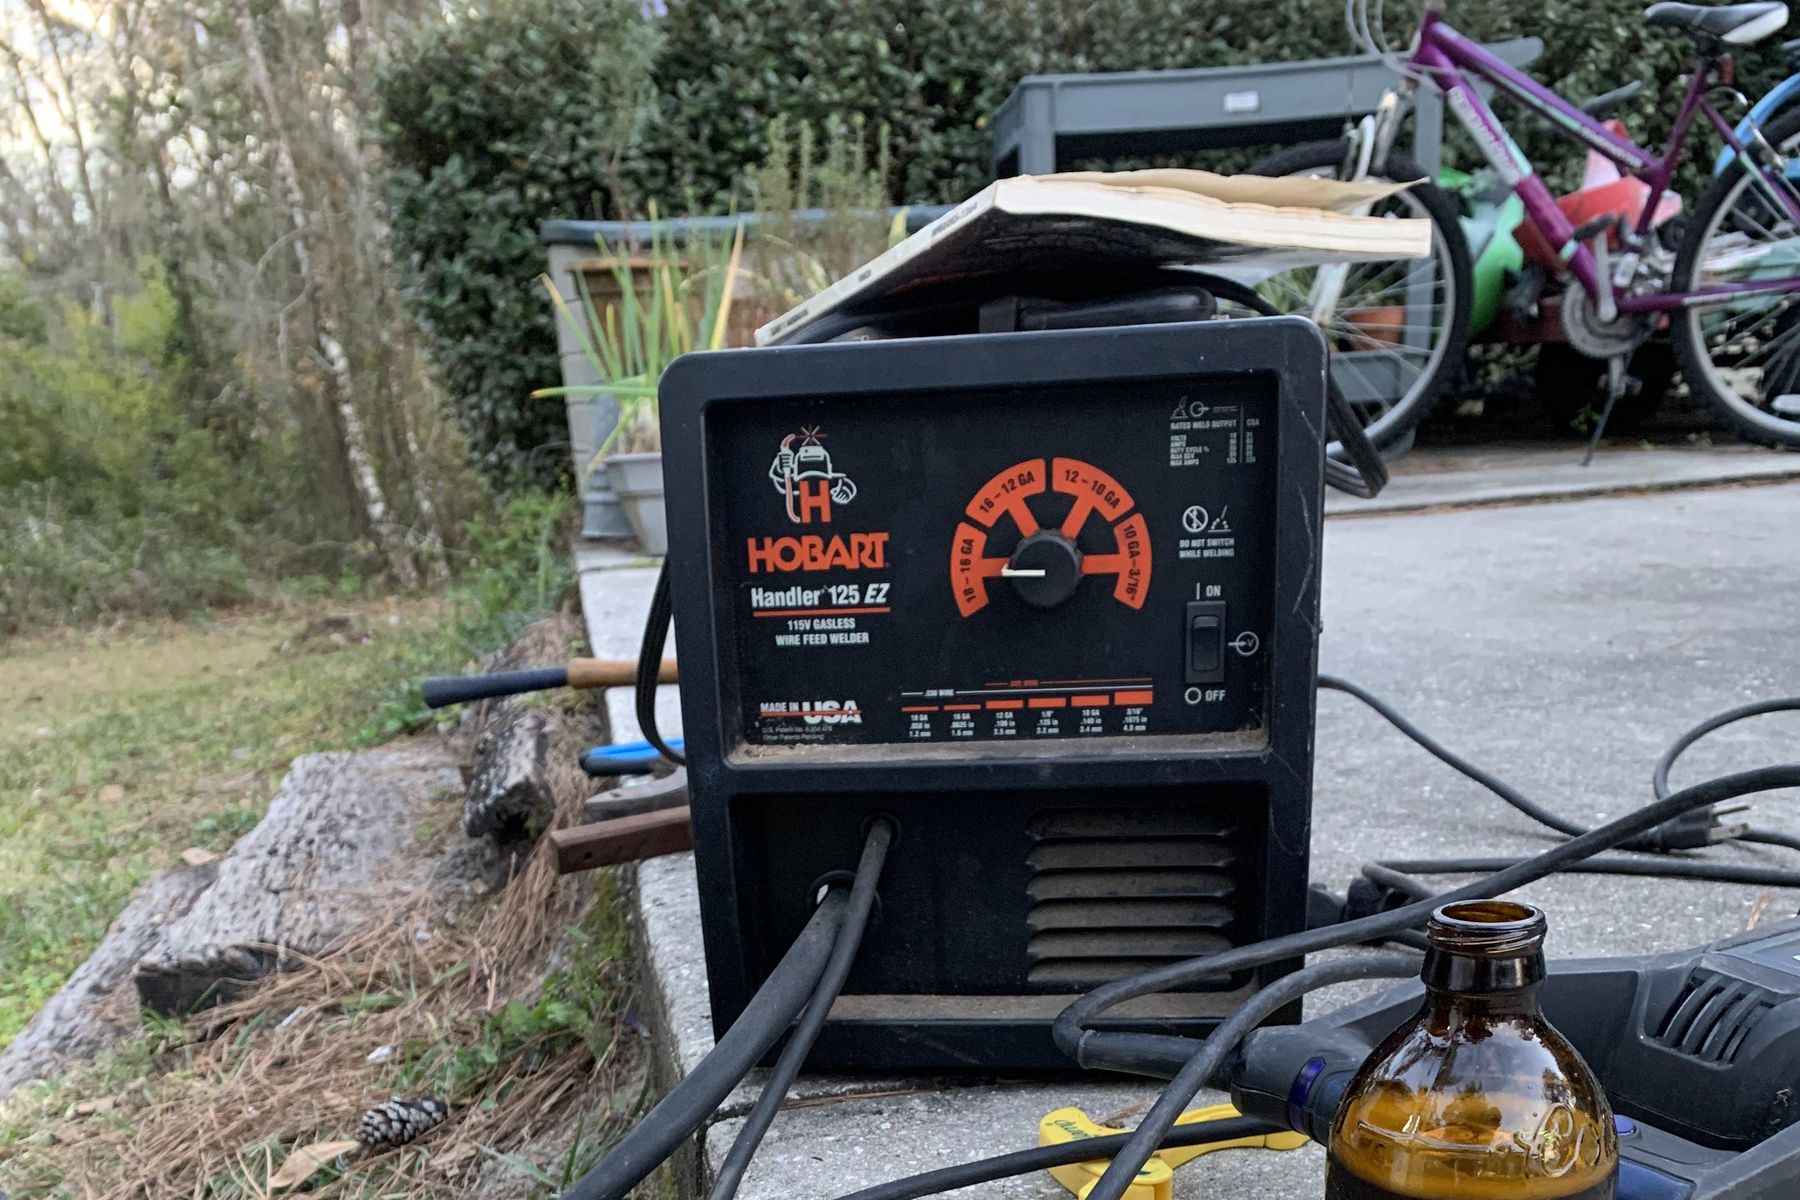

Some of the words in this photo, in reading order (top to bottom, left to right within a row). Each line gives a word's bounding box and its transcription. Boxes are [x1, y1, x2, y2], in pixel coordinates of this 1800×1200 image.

[979, 497, 994, 513] 16
[1001, 478, 1017, 494] 12
[1017, 470, 1036, 486] GA
[1065, 469, 1079, 483] 12
[1091, 480, 1105, 495] 10
[1103, 491, 1121, 510] GA
[799, 479, 832, 524] H
[1122, 523, 1137, 539] 10
[959, 538, 975, 555] GA
[1179, 539, 1190, 548] DO
[1191, 538, 1206, 547] NOT
[1206, 537, 1235, 547] SWITCH
[747, 531, 890, 574] HOBART
[1179, 549, 1201, 559] WHILE
[1202, 548, 1235, 558] WELDING
[959, 559, 972, 573] 16
[751, 586, 822, 608] Handler
[828, 584, 860, 605] 125
[864, 582, 891, 604] EZ
[963, 587, 977, 603] 18
[1205, 584, 1222, 597] ON
[787, 619, 812, 631] 115V
[813, 617, 856, 630] GASLESS
[775, 634, 801, 646] WIRE
[802, 633, 828, 645] FEED
[829, 631, 870, 644] WELDER
[1204, 689, 1226, 702] OFF
[760, 702, 787, 713] MADE
[788, 701, 799, 712] IN
[802, 699, 862, 724] USA
